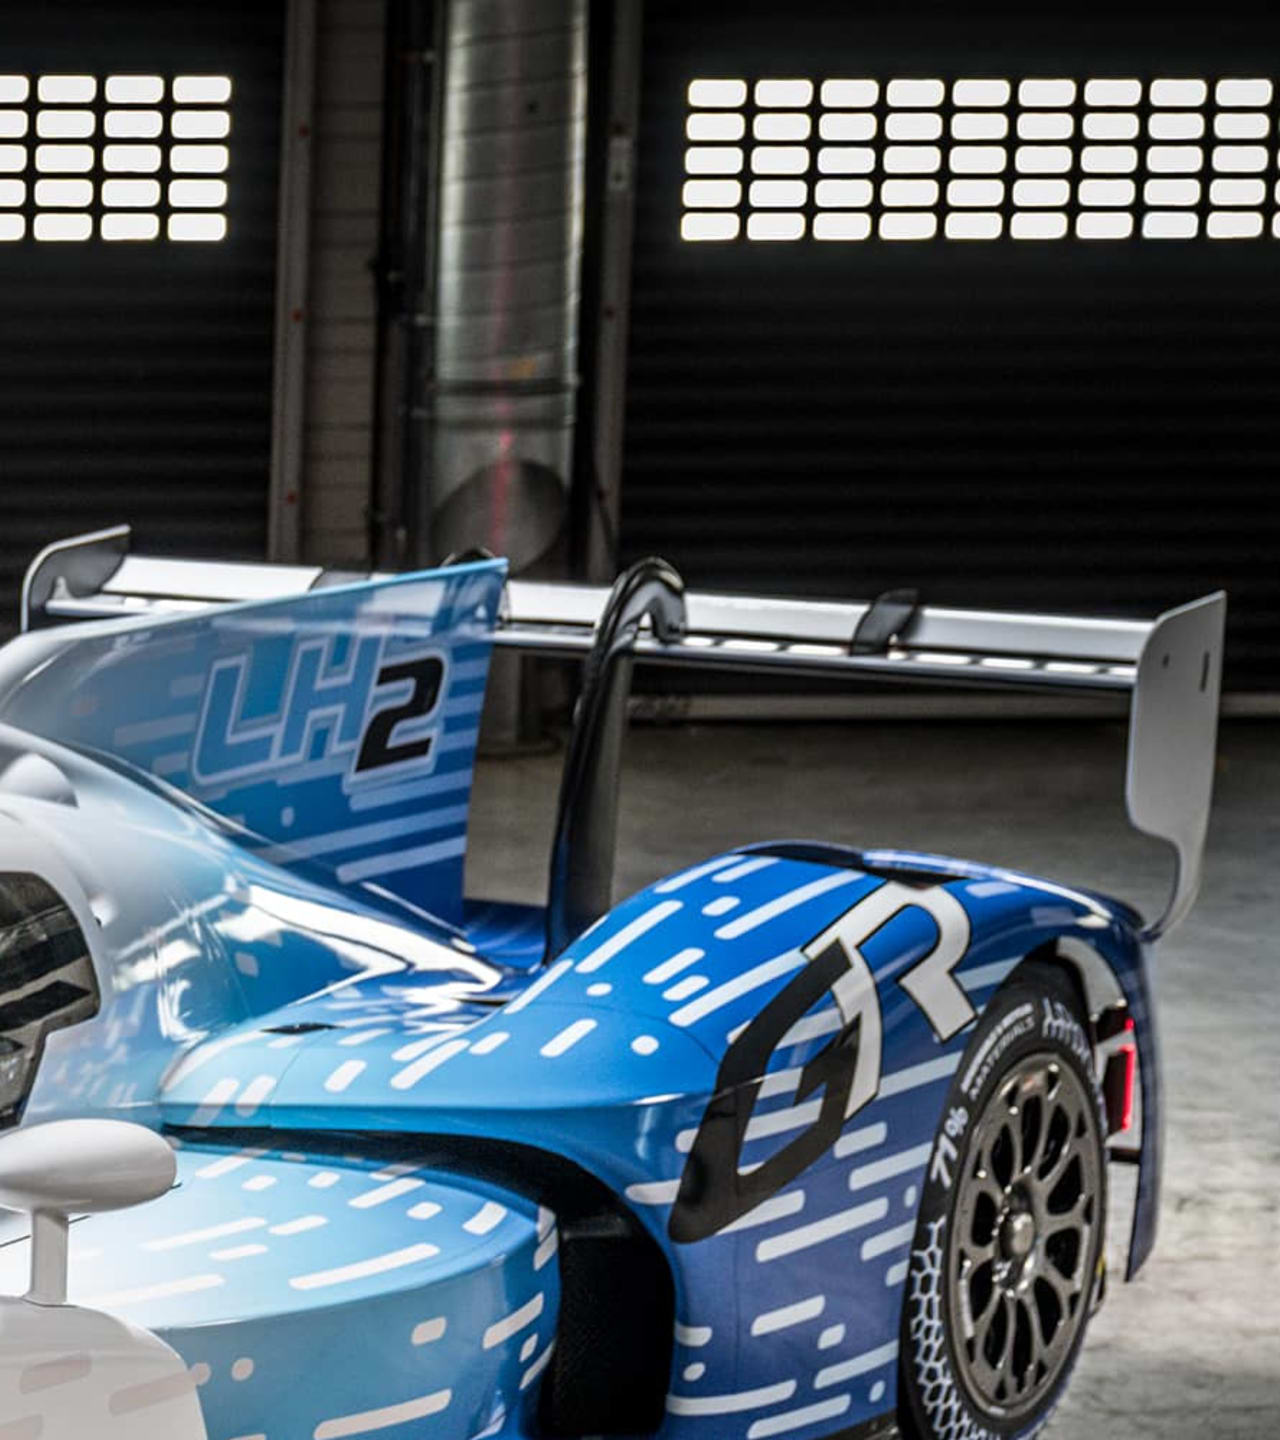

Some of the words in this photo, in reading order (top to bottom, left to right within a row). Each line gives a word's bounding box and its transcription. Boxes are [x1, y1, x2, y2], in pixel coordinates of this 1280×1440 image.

[193, 635, 451, 793] LH2
[668, 880, 979, 1243] GR
[930, 1105, 969, 1190] 71%
